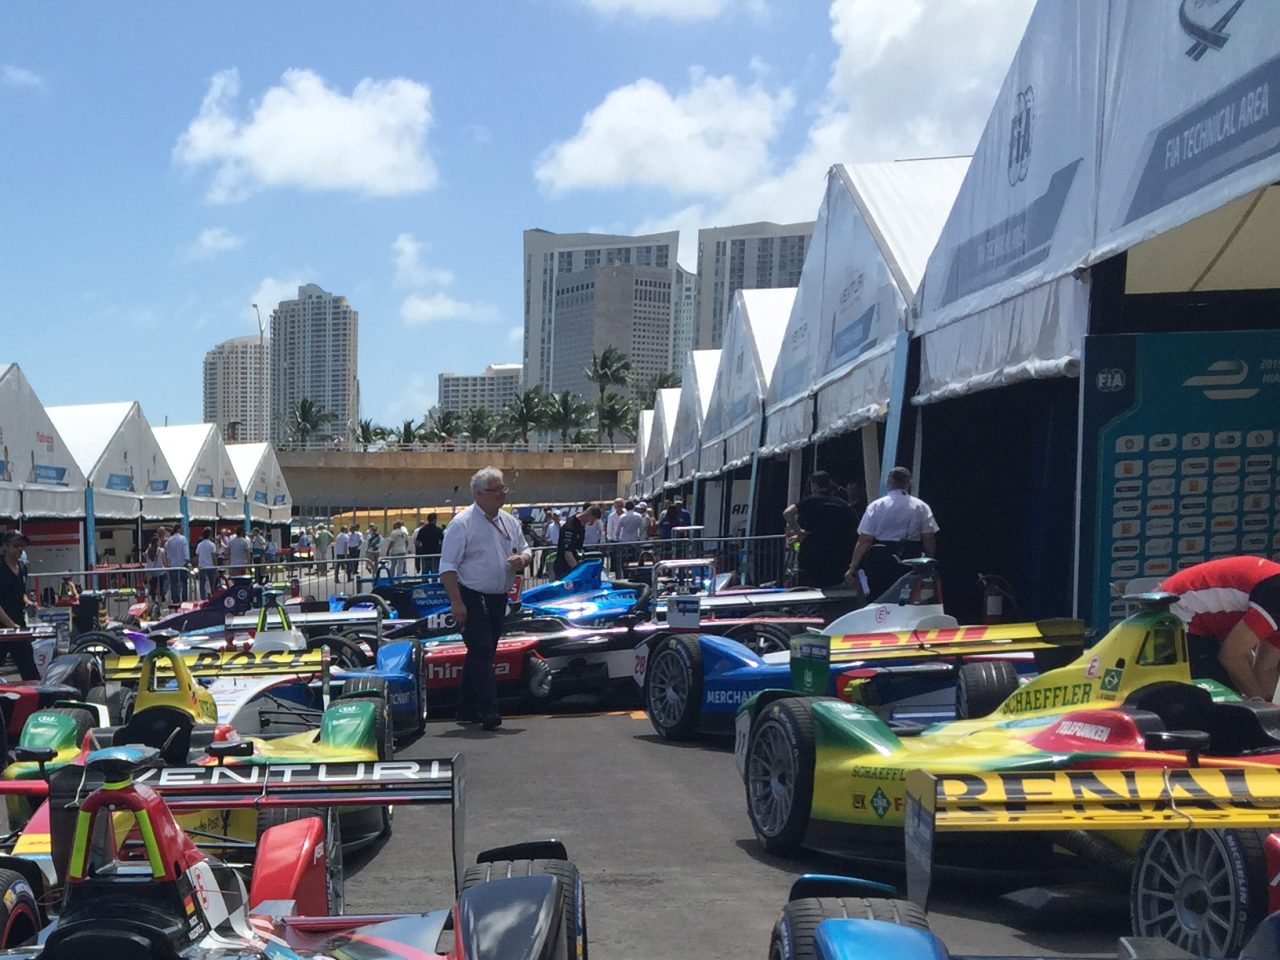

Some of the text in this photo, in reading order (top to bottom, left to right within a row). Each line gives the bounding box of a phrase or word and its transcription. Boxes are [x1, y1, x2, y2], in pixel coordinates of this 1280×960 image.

[1097, 373, 1123, 387] FIA
[37, 655, 46, 667] 3
[634, 655, 647, 674] 28
[1002, 682, 1093, 716] SCHAEFFLER
[1056, 720, 1111, 743] TELEFUNKEN
[130, 759, 440, 787] VENTURI
[851, 765, 907, 782] SCHAEFFL
[934, 771, 1280, 811] RENAU
